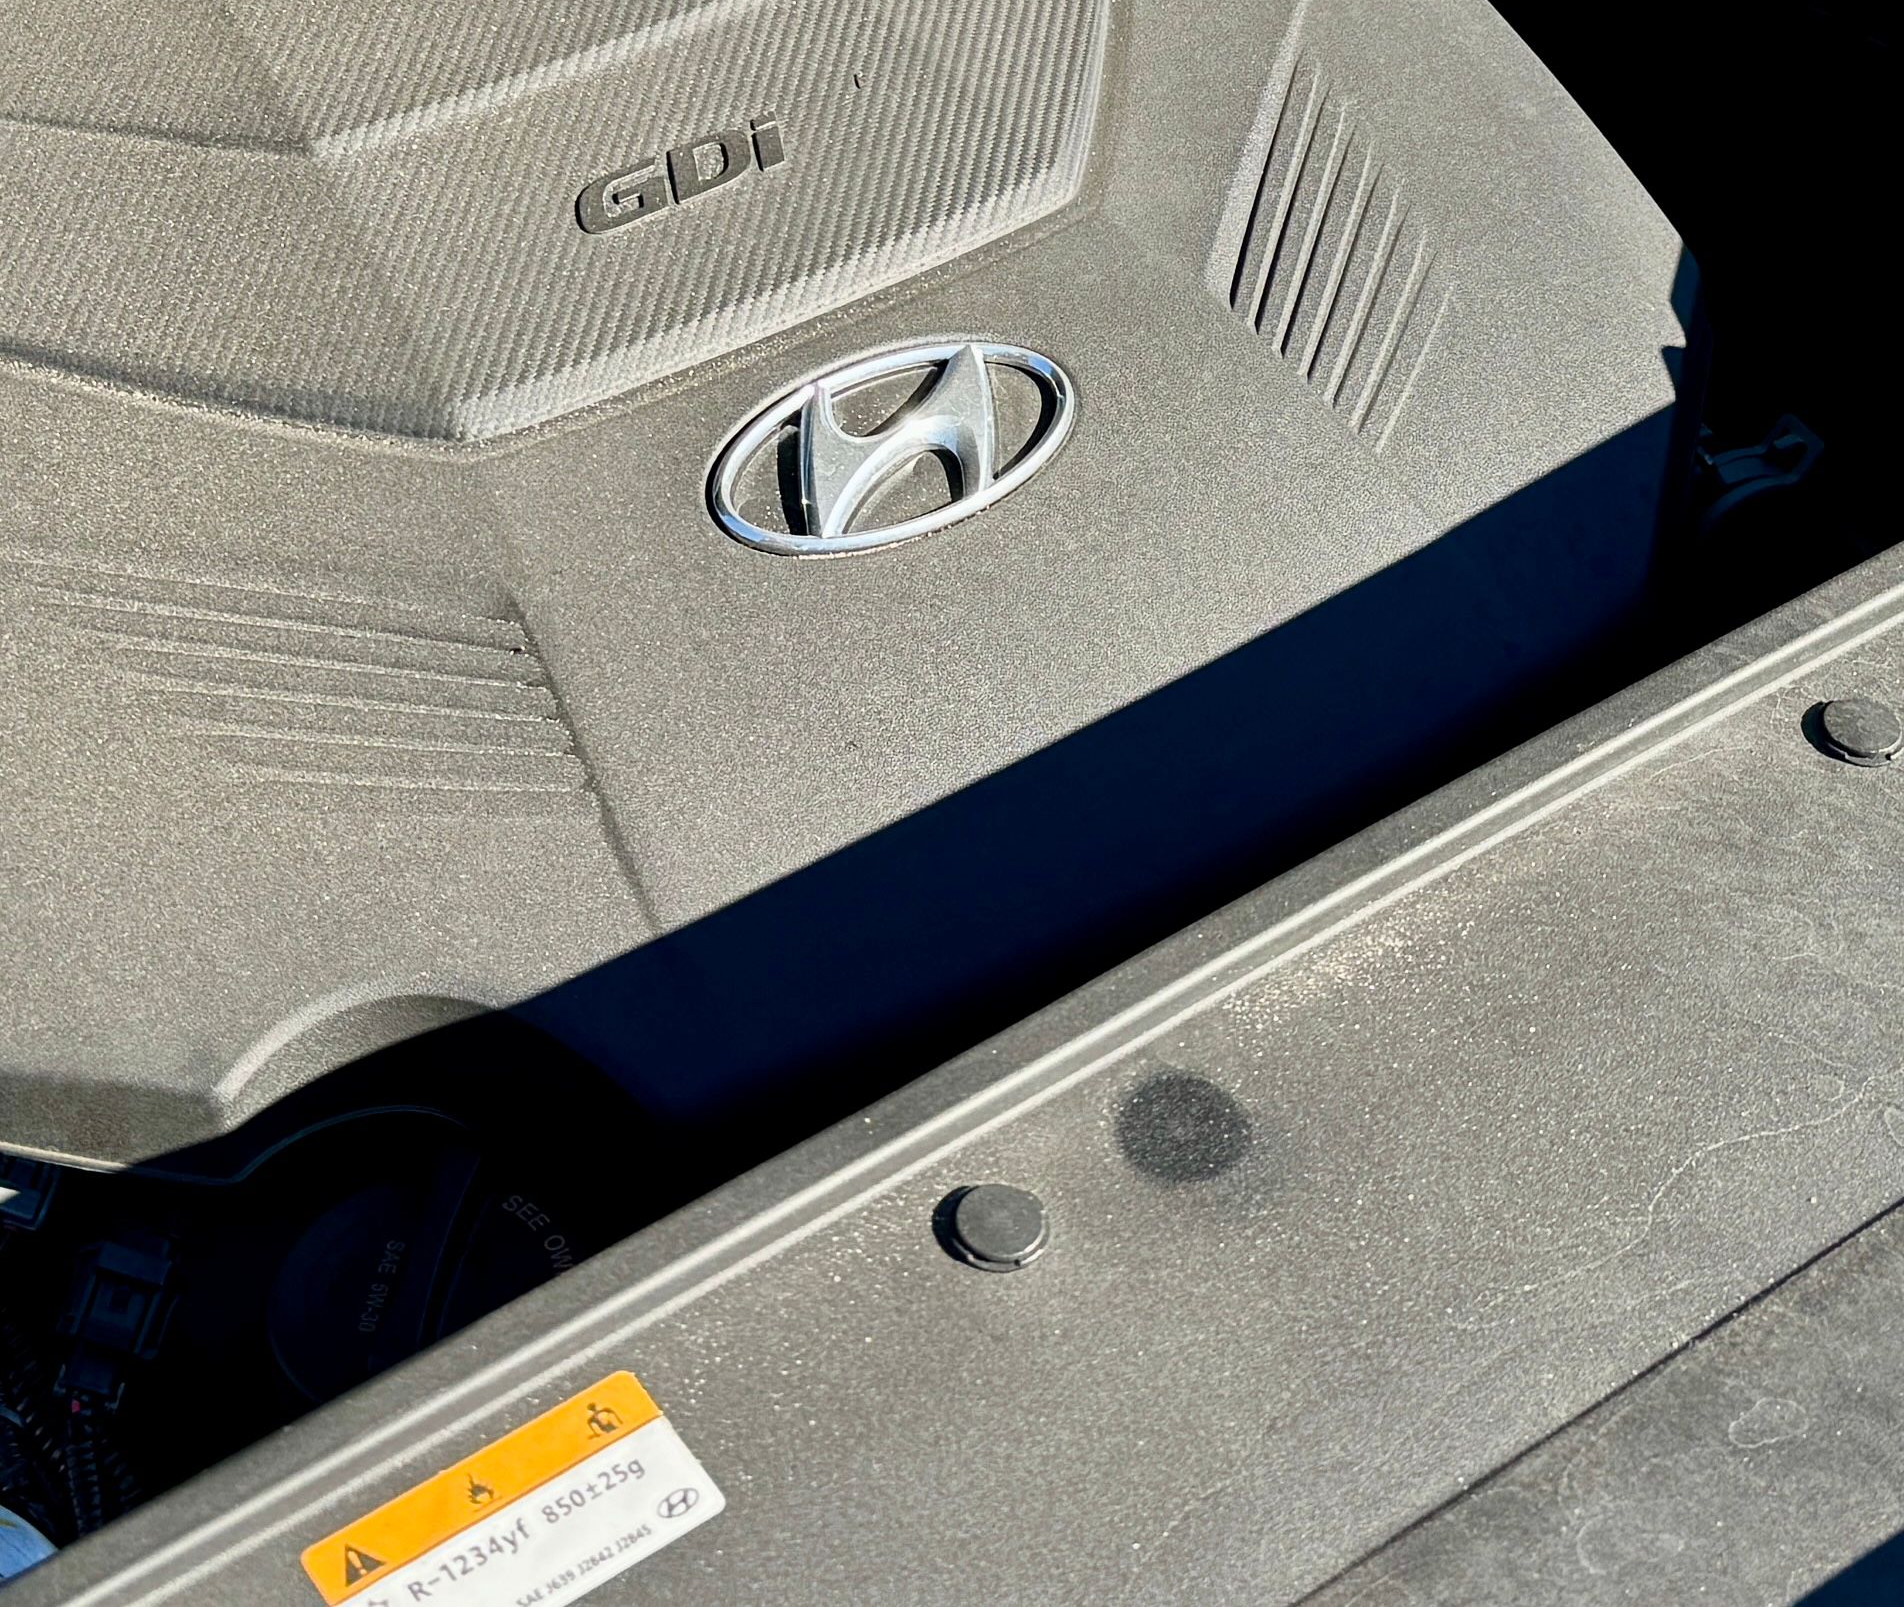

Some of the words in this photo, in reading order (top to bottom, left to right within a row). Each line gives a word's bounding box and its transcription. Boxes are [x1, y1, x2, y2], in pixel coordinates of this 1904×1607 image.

[574, 109, 786, 235] GDi
[377, 1238, 407, 1275] SAE
[500, 1194, 552, 1232] SEE
[542, 1234, 575, 1277] OW
[356, 1282, 390, 1334] 5W-30
[406, 1517, 531, 1603] R-1234yf
[540, 1457, 647, 1525] 850±25g
[546, 1568, 577, 1600] J639
